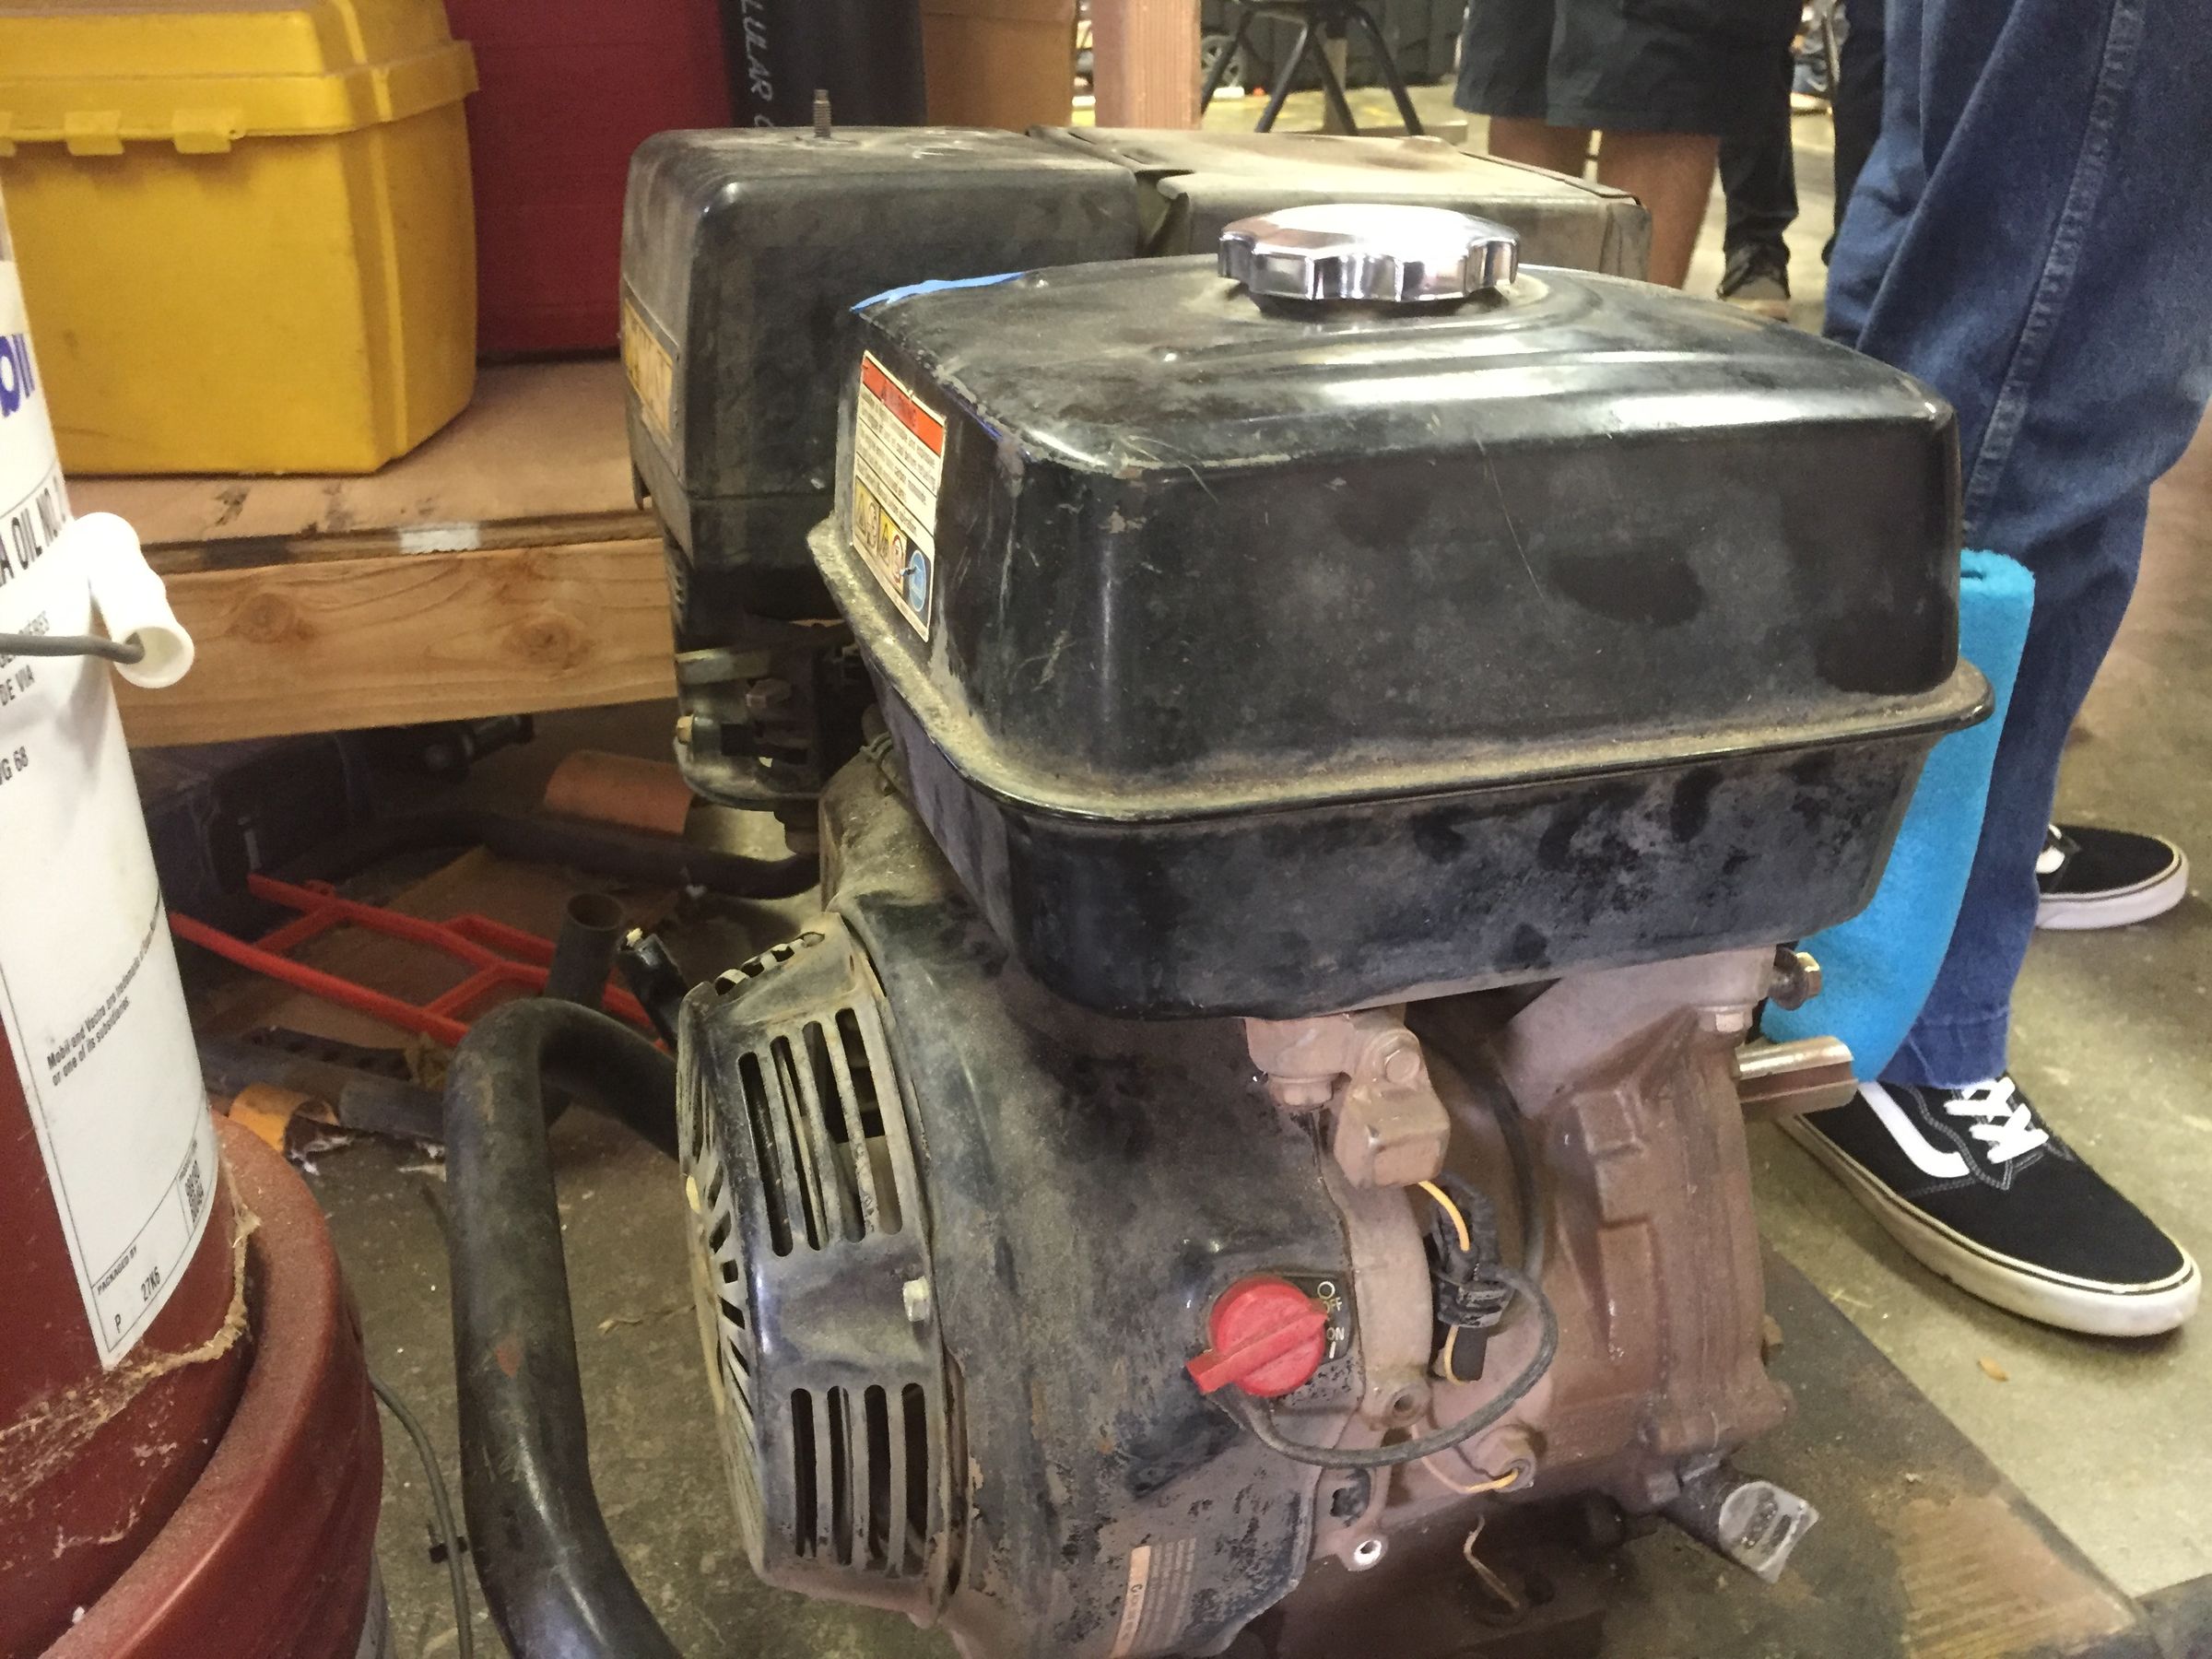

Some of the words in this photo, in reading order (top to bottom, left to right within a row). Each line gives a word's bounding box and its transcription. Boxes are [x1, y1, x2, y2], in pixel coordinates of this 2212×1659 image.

[11, 516, 42, 570] OIL
[13, 746, 29, 771] 68
[47, 1039, 71, 1069] Mobil
[71, 1025, 86, 1048] and
[53, 1071, 61, 1086] or
[63, 1057, 77, 1077] one
[78, 1044, 86, 1062] of
[97, 1255, 130, 1296] PACKAGED
[114, 1313, 122, 1334] P
[1326, 1326, 1345, 1341] ON
